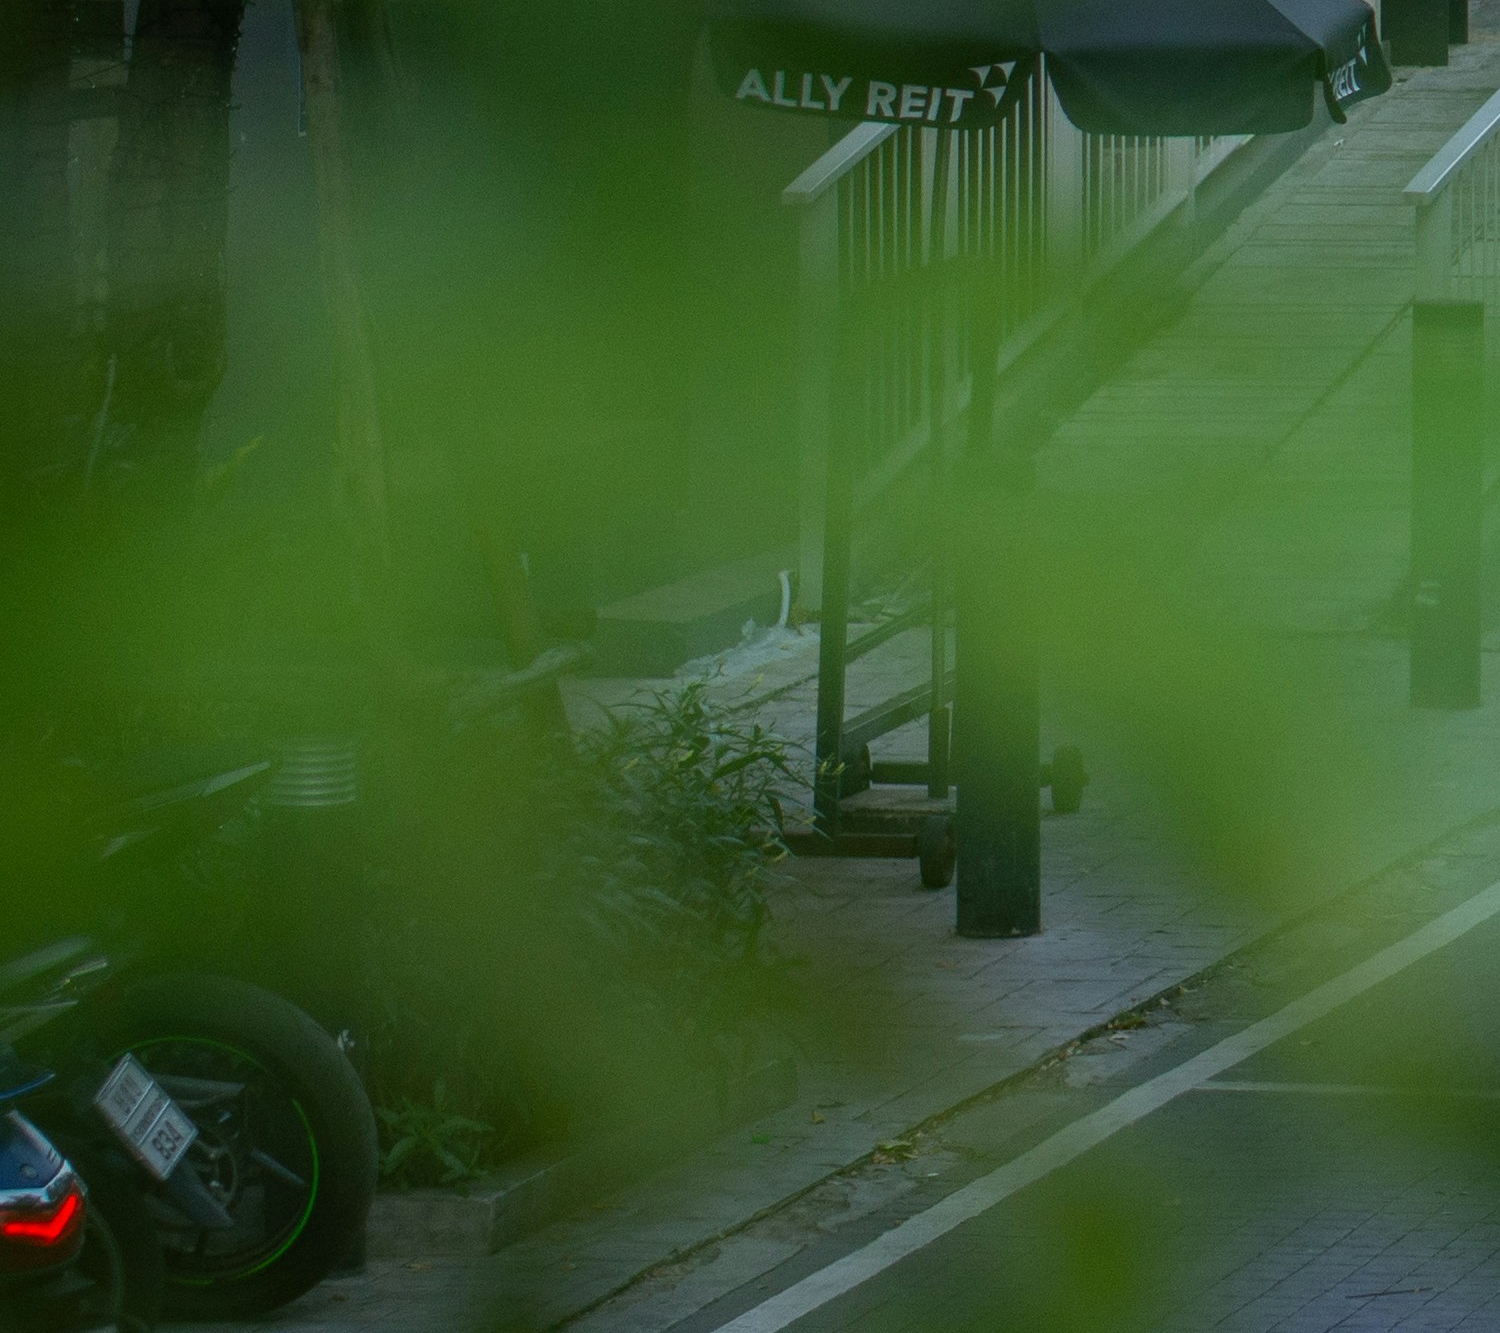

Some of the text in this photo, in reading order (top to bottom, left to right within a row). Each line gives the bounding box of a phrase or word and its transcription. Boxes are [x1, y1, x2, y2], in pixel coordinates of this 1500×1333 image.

[734, 68, 975, 123] ALLY REIT
[152, 1120, 184, 1160] 834
